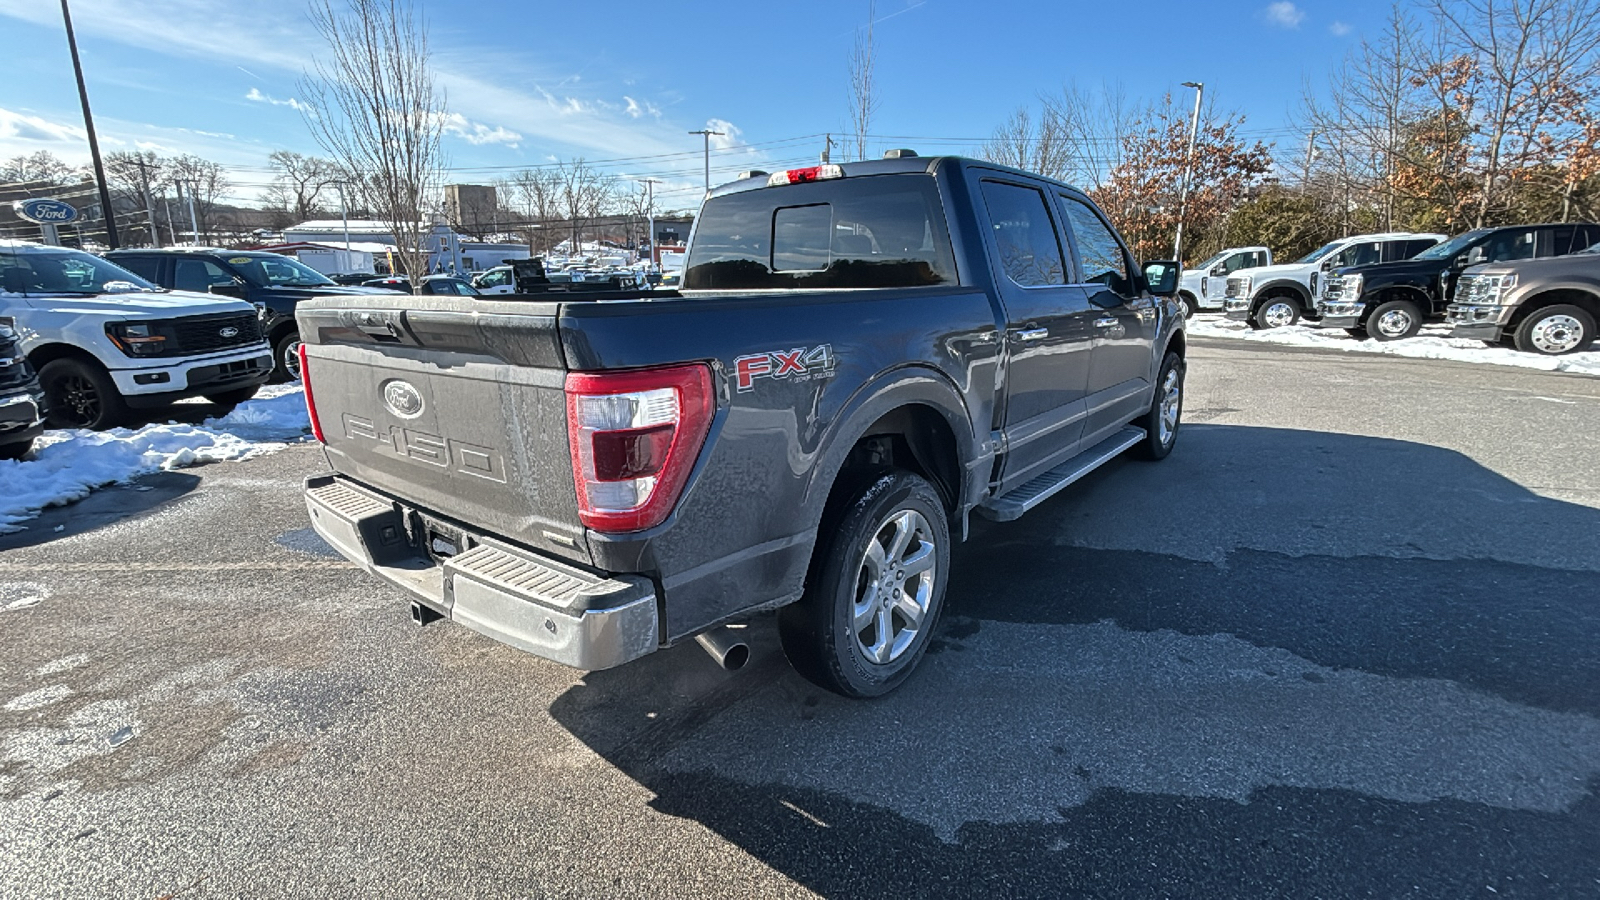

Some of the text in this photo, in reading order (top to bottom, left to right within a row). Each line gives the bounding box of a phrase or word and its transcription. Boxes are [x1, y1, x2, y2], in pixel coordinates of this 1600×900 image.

[35, 204, 67, 219] Ford
[733, 343, 835, 393] FX4
[341, 412, 507, 483] F-150
